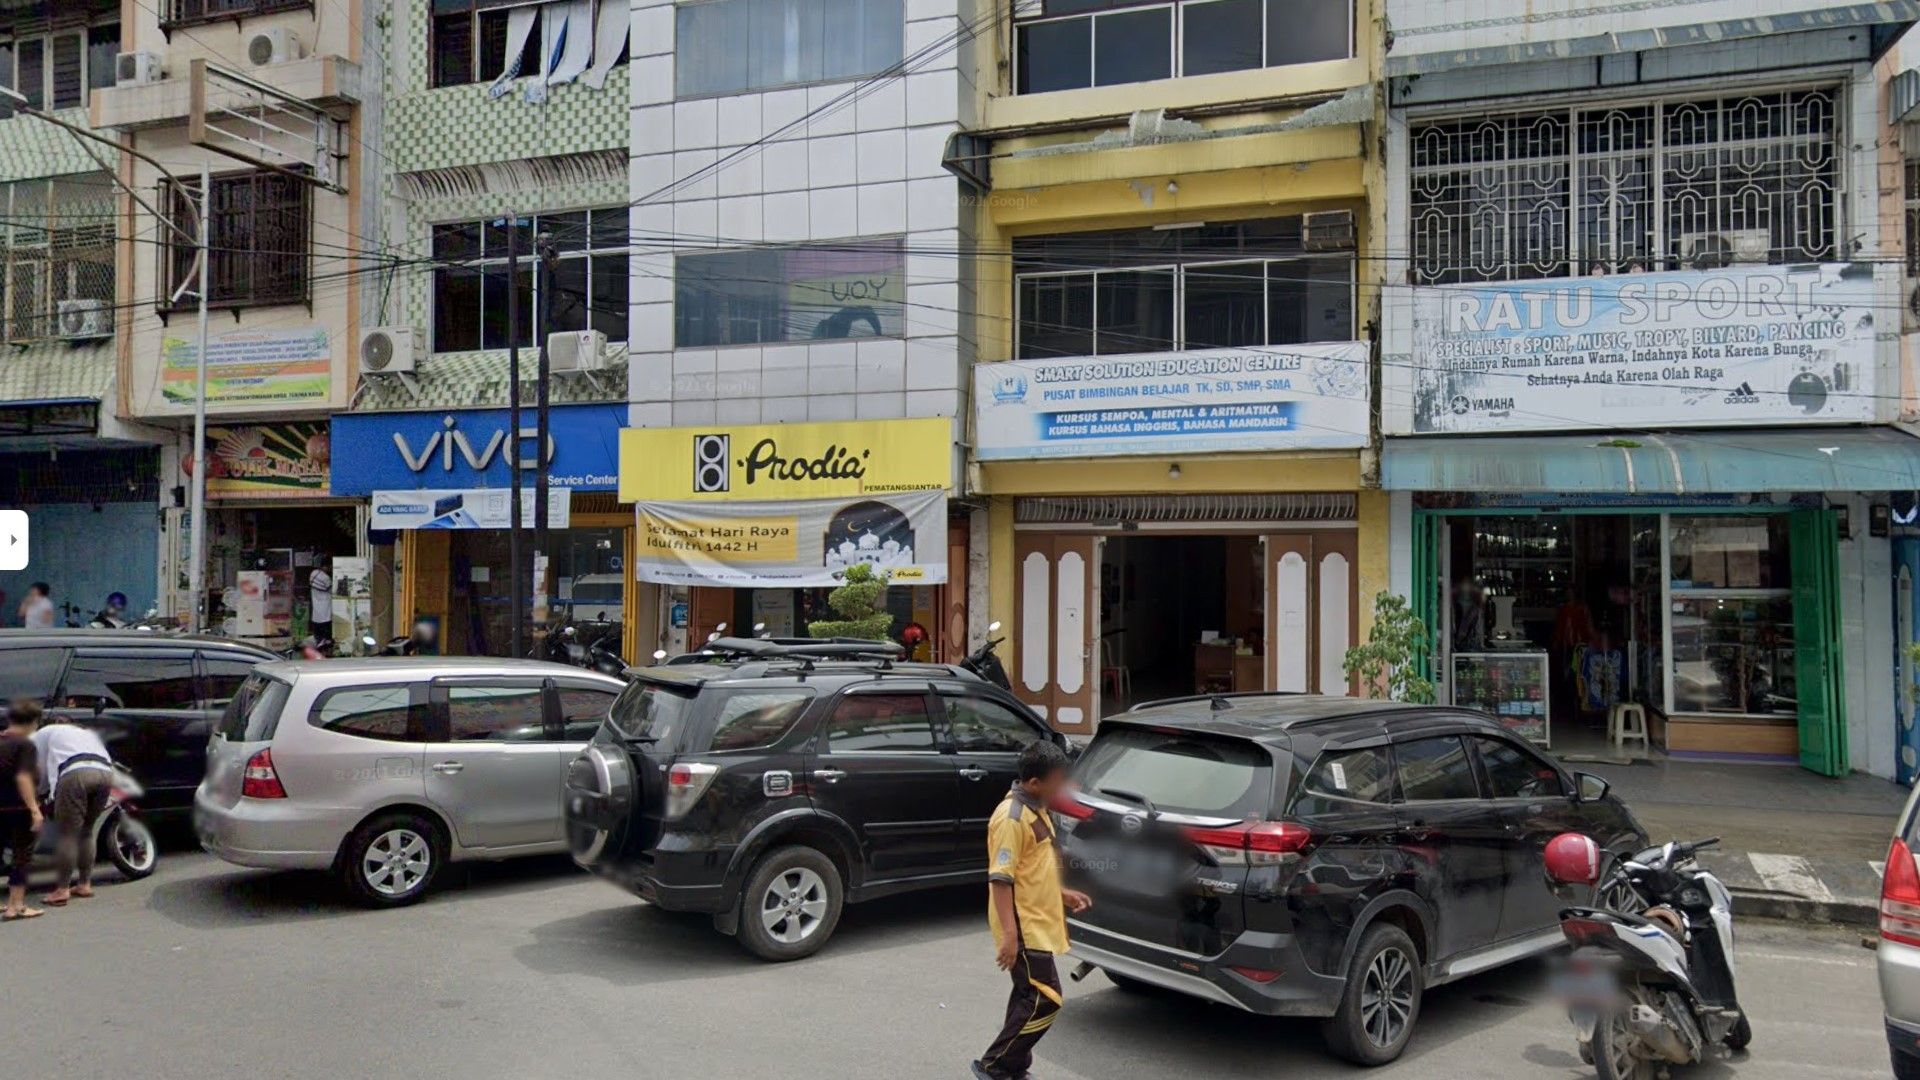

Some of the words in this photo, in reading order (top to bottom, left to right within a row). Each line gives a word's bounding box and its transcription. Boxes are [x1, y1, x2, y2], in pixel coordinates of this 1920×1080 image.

[1450, 287, 1592, 332] RATU
[1618, 272, 1821, 325] SPORT
[1436, 339, 1511, 357] SPECIALIST
[1524, 336, 1574, 354] SPORT,
[1577, 331, 1633, 349] MUSIC,
[1634, 329, 1689, 348] TROPY,
[1692, 325, 1765, 344] BILYARD,
[1768, 320, 1846, 341] PANCING
[1501, 356, 1541, 369] Rumah
[1544, 354, 1585, 366] Karena
[1588, 352, 1629, 365] Warna,
[1632, 350, 1688, 364] Indahnya
[1692, 347, 1721, 360] Kota
[1725, 345, 1769, 358] Karena
[1036, 366, 1083, 383] SMART
[1084, 362, 1155, 381] SOLUTION
[1157, 356, 1243, 377] EDUCATION
[1245, 354, 1302, 372] CENTRE
[1527, 373, 1580, 388] Sehatnya
[1583, 371, 1613, 384] Anda
[1617, 369, 1659, 382] Karena
[1662, 366, 1690, 380] Olah
[1693, 366, 1724, 381] Raga
[1044, 389, 1076, 400] PUSAT
[1079, 386, 1138, 399] BIMBINGAN
[1142, 382, 1190, 396] BELAJAR
[1196, 382, 1213, 394] TK,
[1216, 381, 1233, 393] SD,
[1237, 379, 1263, 392] SMP,
[1266, 378, 1291, 390] SMA
[1472, 397, 1515, 411] YAMAHA
[1724, 394, 1760, 405] adidas
[1056, 412, 1098, 424] KURSUS
[1101, 410, 1148, 422] SEMPOA,
[1152, 407, 1194, 420] MENTAL
[1198, 406, 1207, 417] &
[1210, 405, 1279, 417] ARITMATIKA
[1048, 425, 1088, 435] KURSUS
[1090, 423, 1131, 434] BAHASA
[1134, 420, 1180, 433] INGGRIS,
[1183, 419, 1226, 430] BAHASA
[1228, 416, 1288, 428] MANDARIN
[393, 415, 555, 471] vivo
[745, 438, 868, 485] Prodia
[548, 475, 583, 486] Service
[585, 474, 618, 486] Center
[863, 484, 943, 492] PEMATANGSIANTAR
[646, 522, 705, 538] Selamat
[711, 526, 744, 538] Hari
[750, 526, 790, 539] Raya
[706, 542, 741, 552] 1442
[747, 542, 758, 551] H
